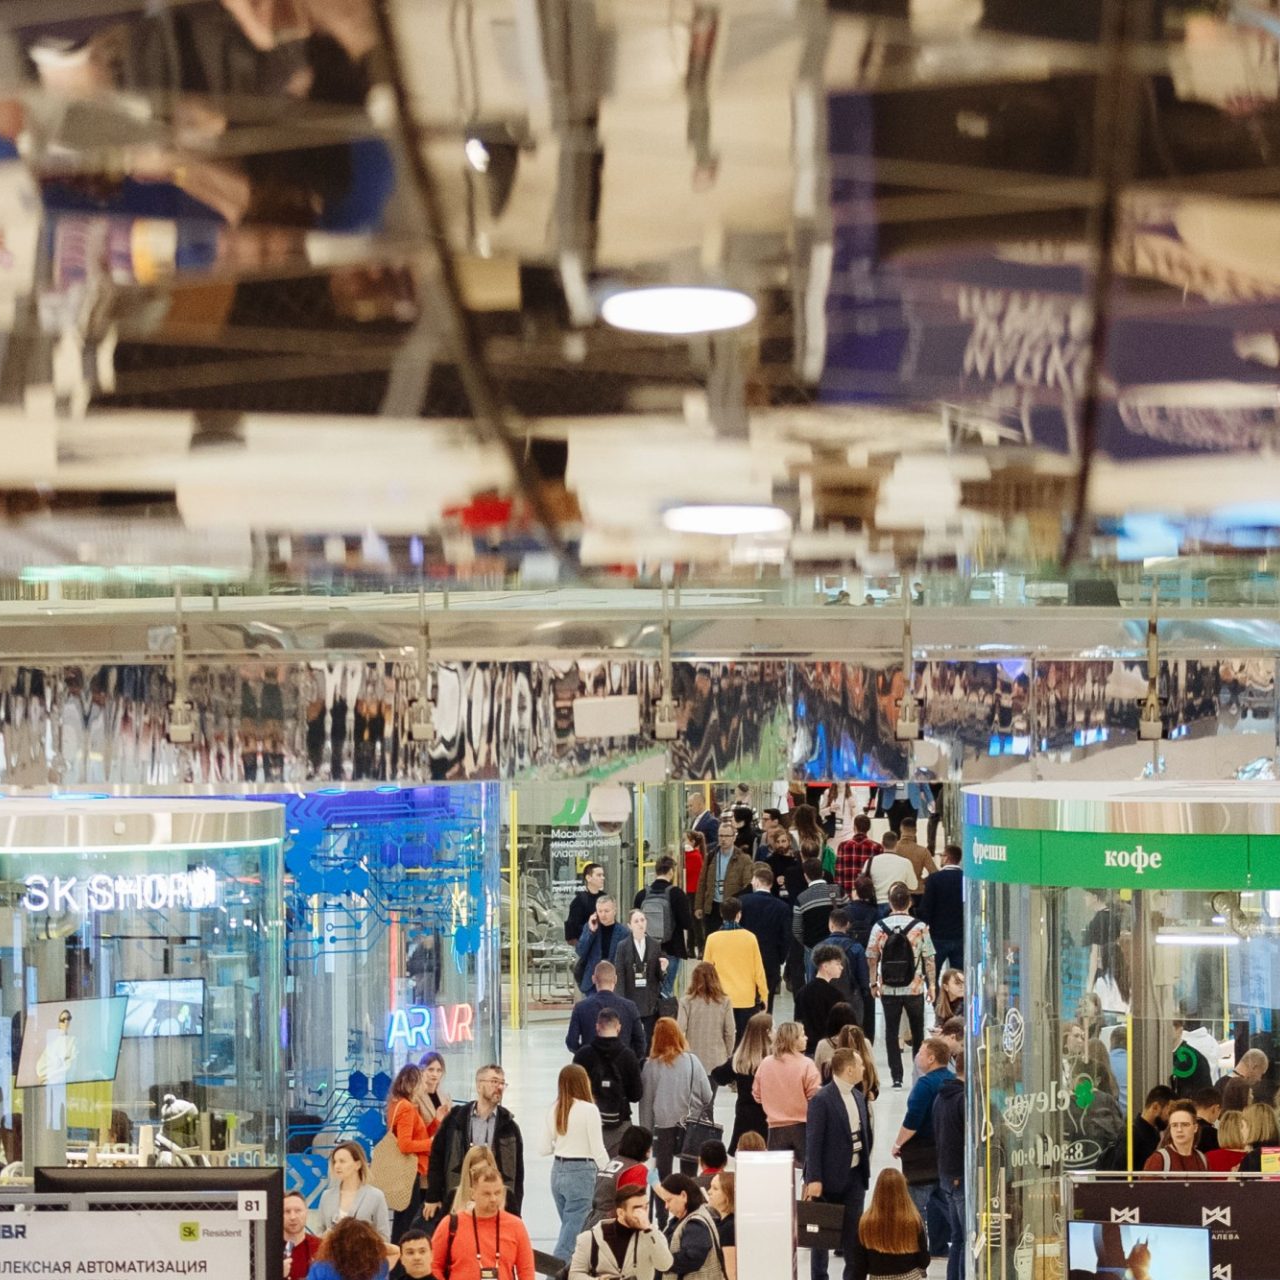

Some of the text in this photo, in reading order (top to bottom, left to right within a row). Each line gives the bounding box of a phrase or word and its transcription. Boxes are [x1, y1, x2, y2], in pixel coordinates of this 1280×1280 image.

[972, 837, 1007, 865] фреши
[1104, 846, 1162, 874] кофе
[23, 874, 80, 912] SK
[386, 1003, 474, 1049] AR VR
[245, 1201, 260, 1212] 81
[202, 1228, 242, 1238] Resident
[76, 1260, 208, 1276] АВТОМАТИЗАЦИЯ
